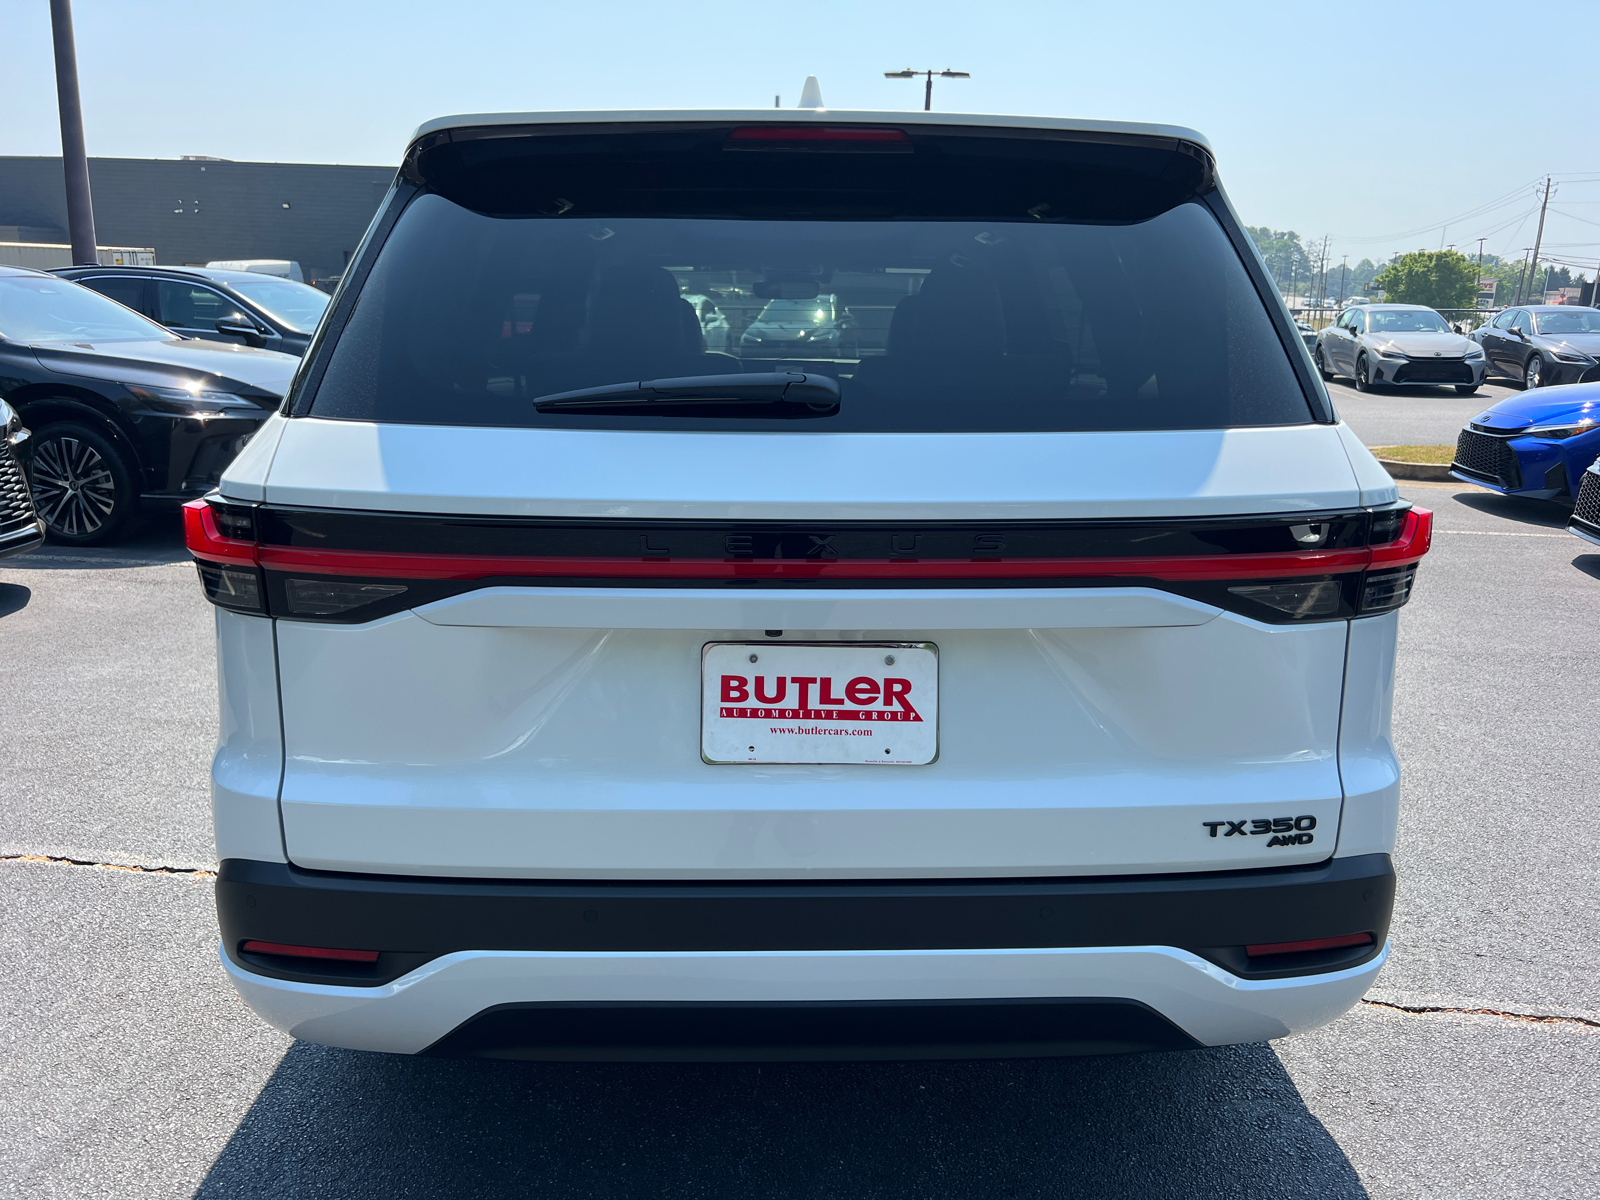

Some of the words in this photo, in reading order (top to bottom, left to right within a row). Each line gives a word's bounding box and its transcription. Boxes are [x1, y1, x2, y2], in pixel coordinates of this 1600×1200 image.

[639, 533, 1006, 555] LEXUS
[721, 708, 839, 719] AUTOMOTIVE
[859, 711, 916, 721] GROUP
[770, 726, 873, 737] www.butlercars.com
[1266, 832, 1314, 848] AWD
